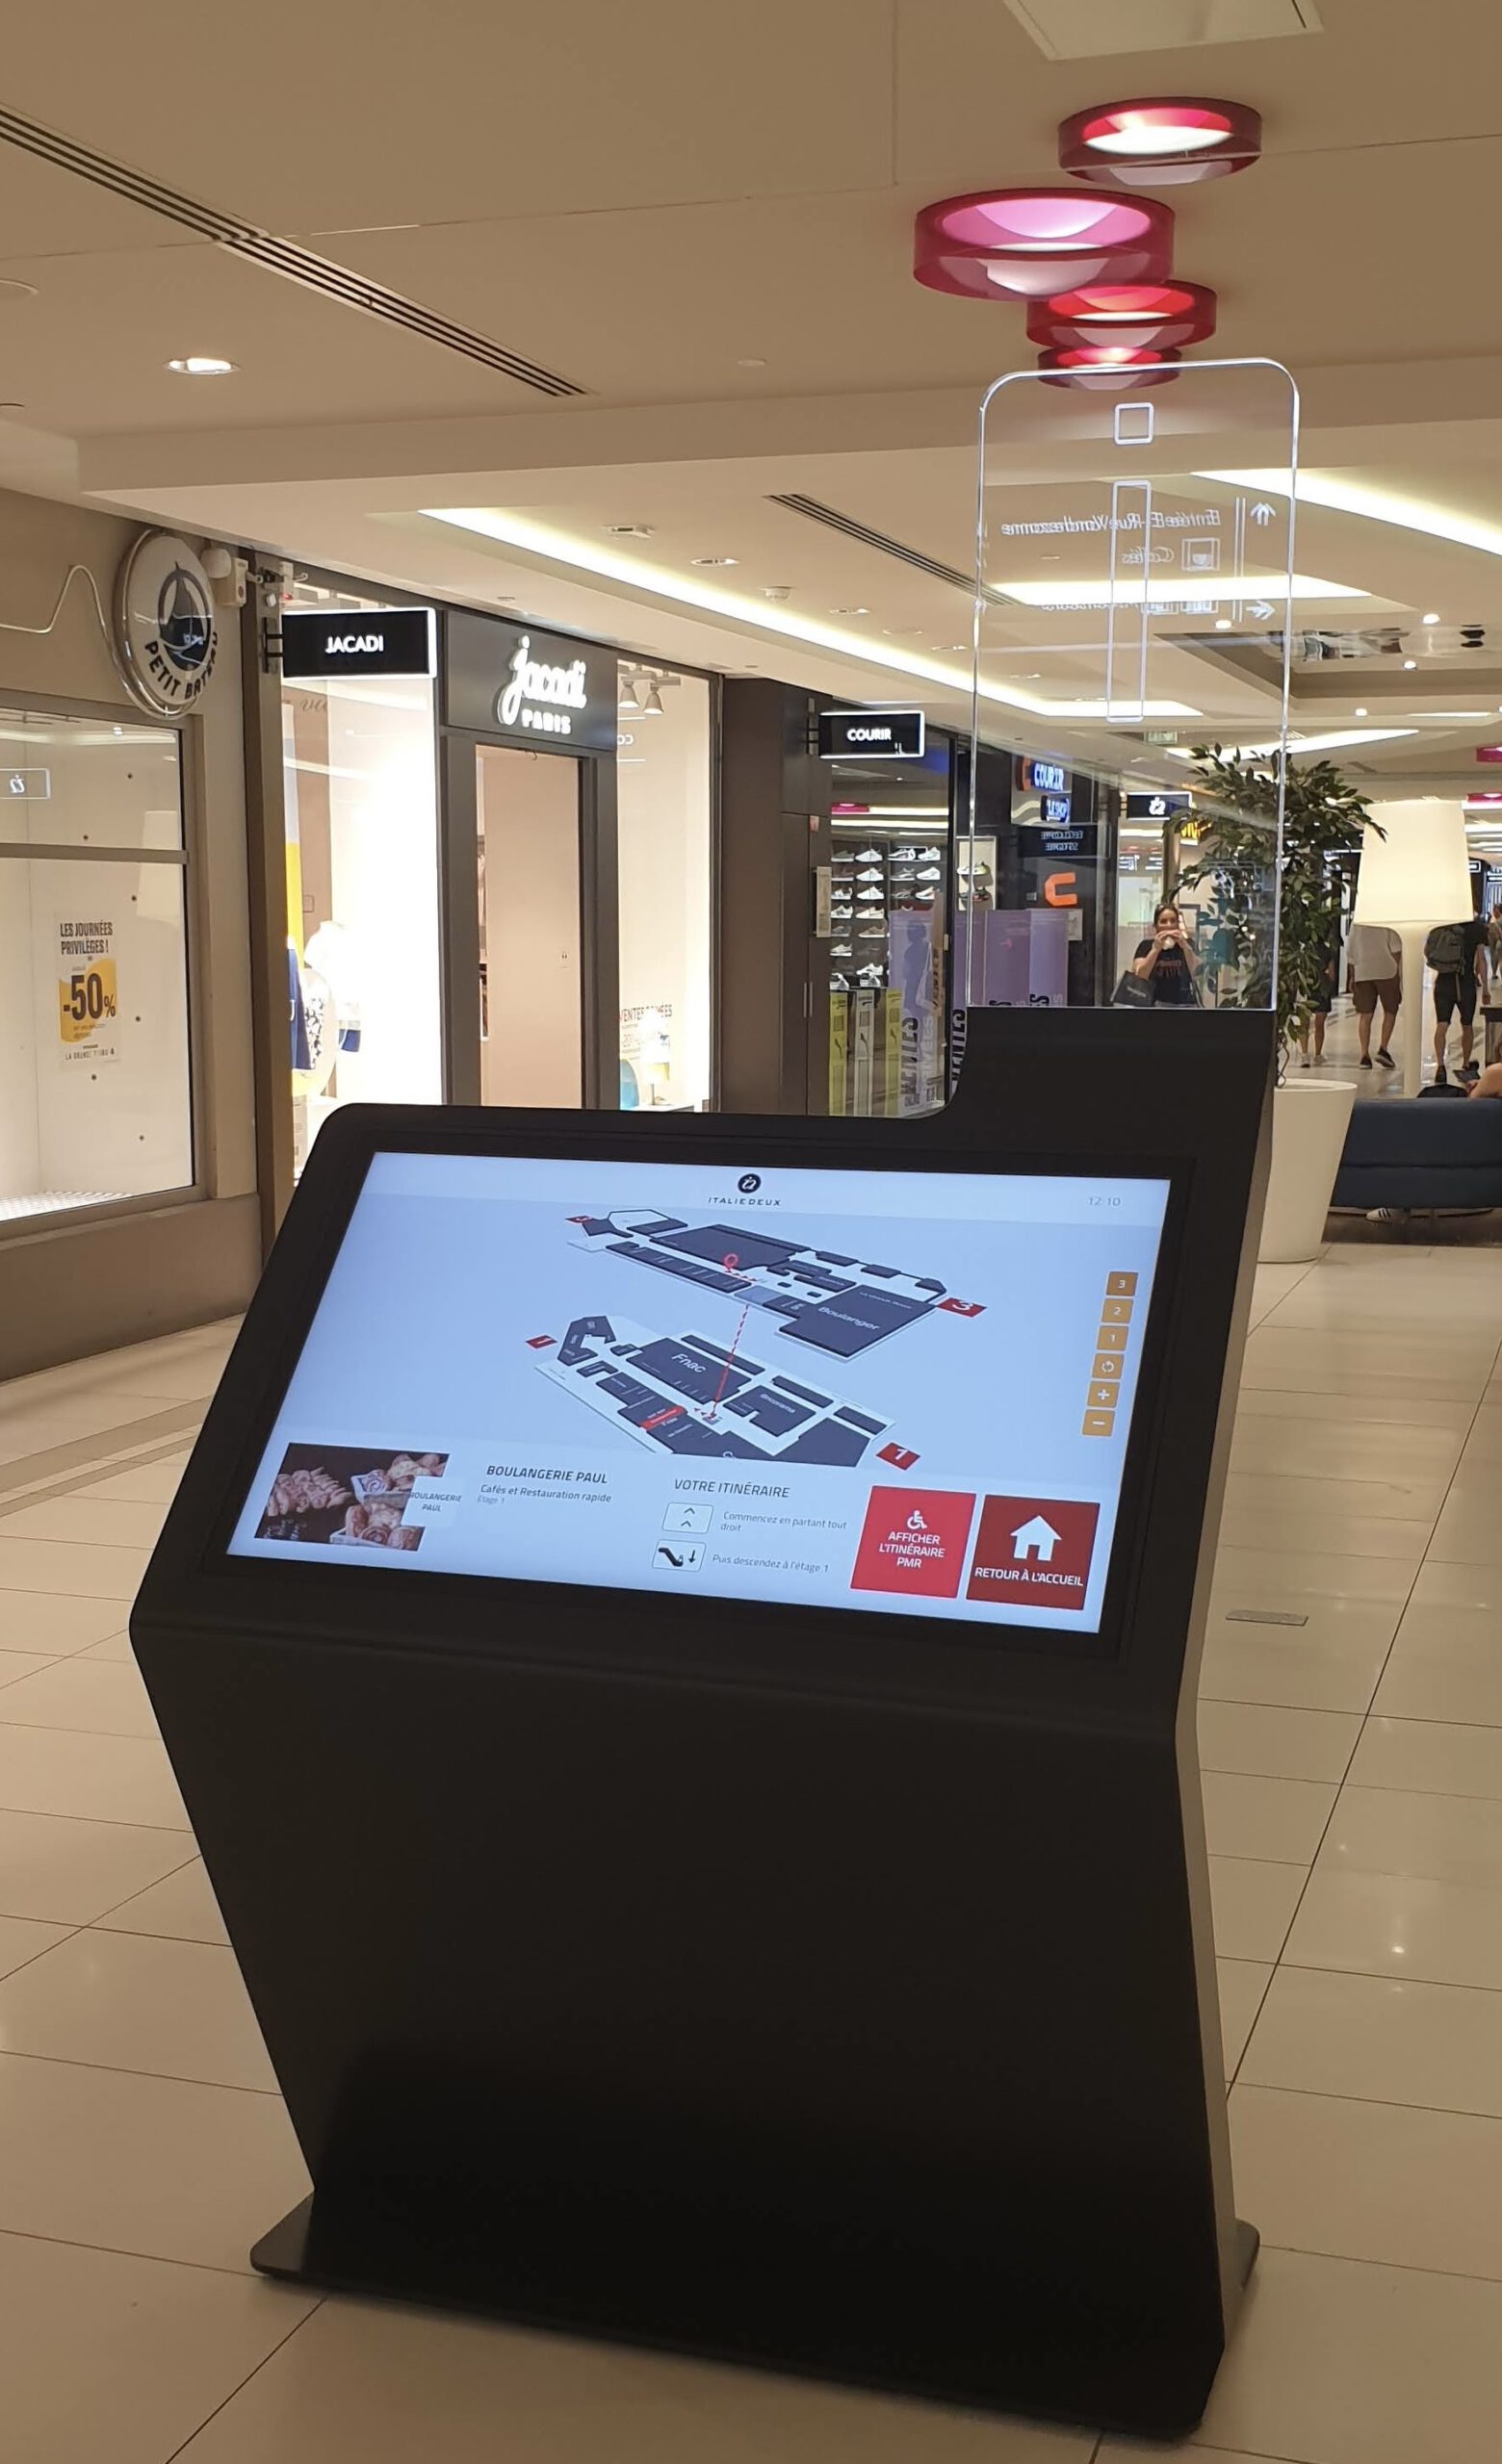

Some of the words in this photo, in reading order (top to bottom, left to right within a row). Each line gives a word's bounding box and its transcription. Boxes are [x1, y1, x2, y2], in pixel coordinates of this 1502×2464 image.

[325, 635, 384, 654] JACADI
[145, 641, 181, 697] PETIT
[498, 635, 586, 725] jacadi
[522, 708, 571, 734] PARIS
[846, 729, 892, 741] COURIR
[1034, 762, 1064, 790] COURIR
[60, 923, 73, 937] LES
[75, 920, 113, 937] JOURNÉES
[61, 937, 105, 955] PRIVILÈGES
[64, 973, 116, 1021] -50%
[1088, 1196, 1121, 1207] 12:10
[1118, 1278, 1126, 1289] 3
[818, 1307, 880, 1329] Boulanger
[1113, 1306, 1122, 1316] 2
[671, 1353, 706, 1373] Fnac
[895, 1448, 908, 1461] 1
[486, 1465, 573, 1481] BOULANGERIE
[577, 1472, 608, 1483] PAUL
[408, 1491, 461, 1502] BOULANGERIE
[480, 1484, 505, 1495] Cafés
[508, 1487, 518, 1496] et
[520, 1487, 580, 1500] Restauration
[582, 1493, 611, 1502] rapide
[674, 1478, 715, 1492] VOTRE
[718, 1481, 790, 1498] ITINÉRAIRE
[422, 1503, 441, 1512] PAUL
[720, 1523, 740, 1532] droit
[723, 1511, 777, 1524] Commencez
[792, 1519, 825, 1529] partant
[828, 1520, 846, 1529] tout
[888, 1531, 941, 1545] AFFICHER
[879, 1542, 945, 1557] L'ITINÉRAIRE
[712, 1554, 731, 1564] Puis
[734, 1556, 781, 1569] descendez
[896, 1556, 922, 1568] PMR
[974, 1567, 1020, 1581] RETOUR
[1021, 1568, 1029, 1580] À
[1031, 1572, 1083, 1586] L'ACCUEIL
